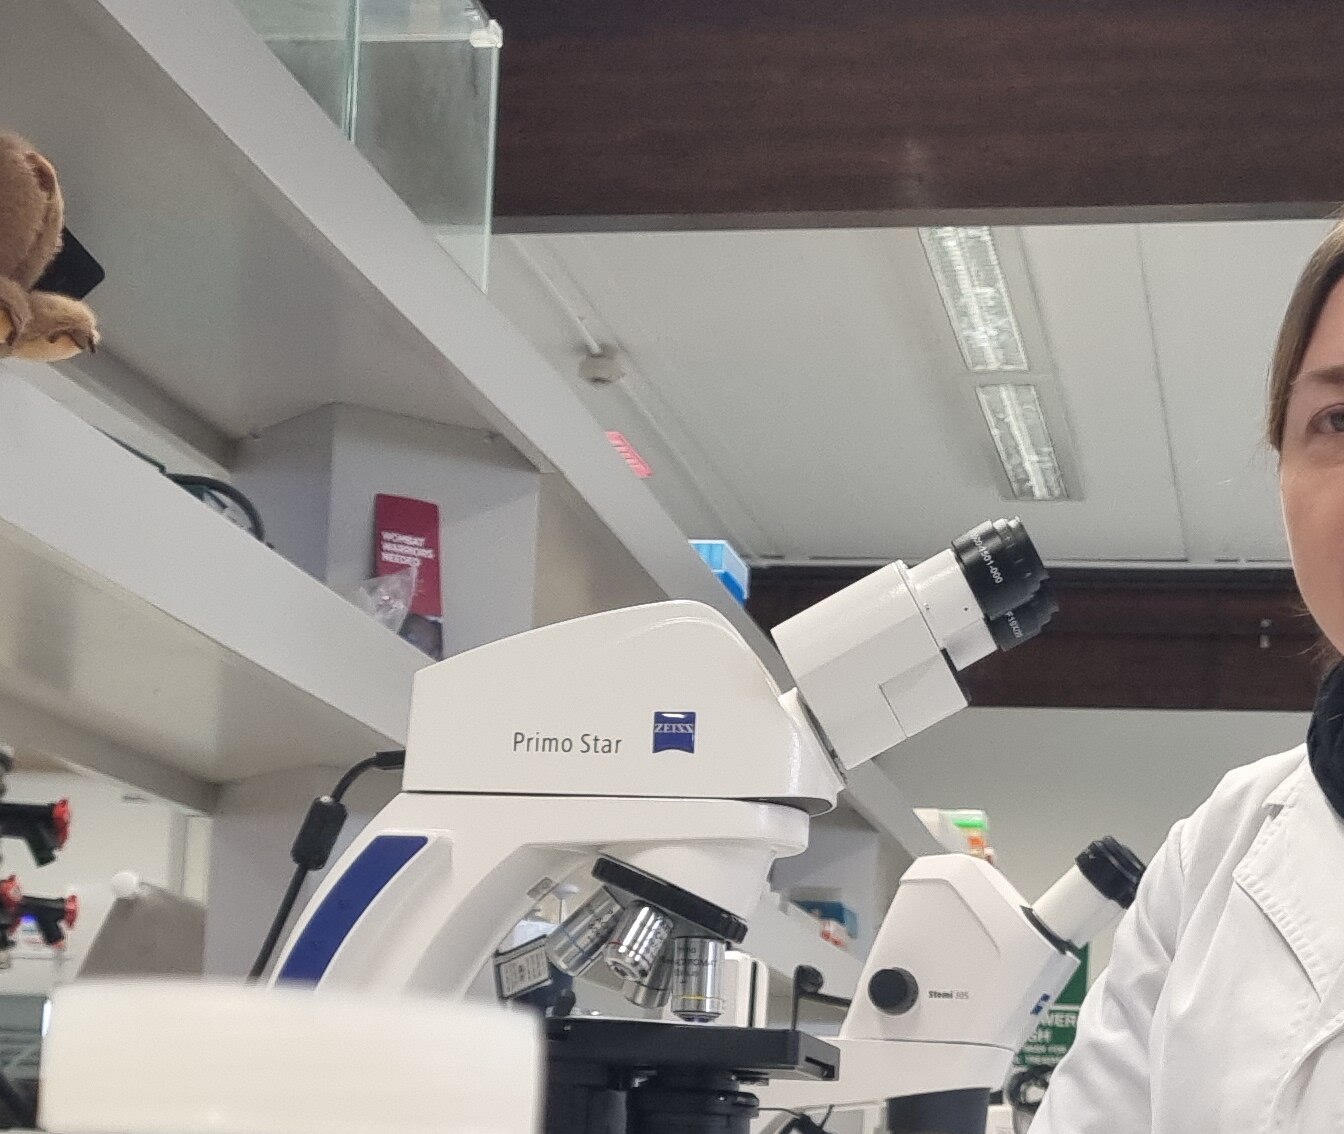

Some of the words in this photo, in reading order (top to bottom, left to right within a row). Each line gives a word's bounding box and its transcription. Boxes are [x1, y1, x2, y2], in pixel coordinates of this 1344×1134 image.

[381, 531, 425, 547] WOMBAT
[381, 541, 435, 559] WARRIORS
[381, 552, 422, 567] NEEDED
[654, 723, 694, 733] ZEISS
[513, 731, 573, 753] Primo
[580, 733, 623, 754] Star
[928, 991, 954, 999] Stemi
